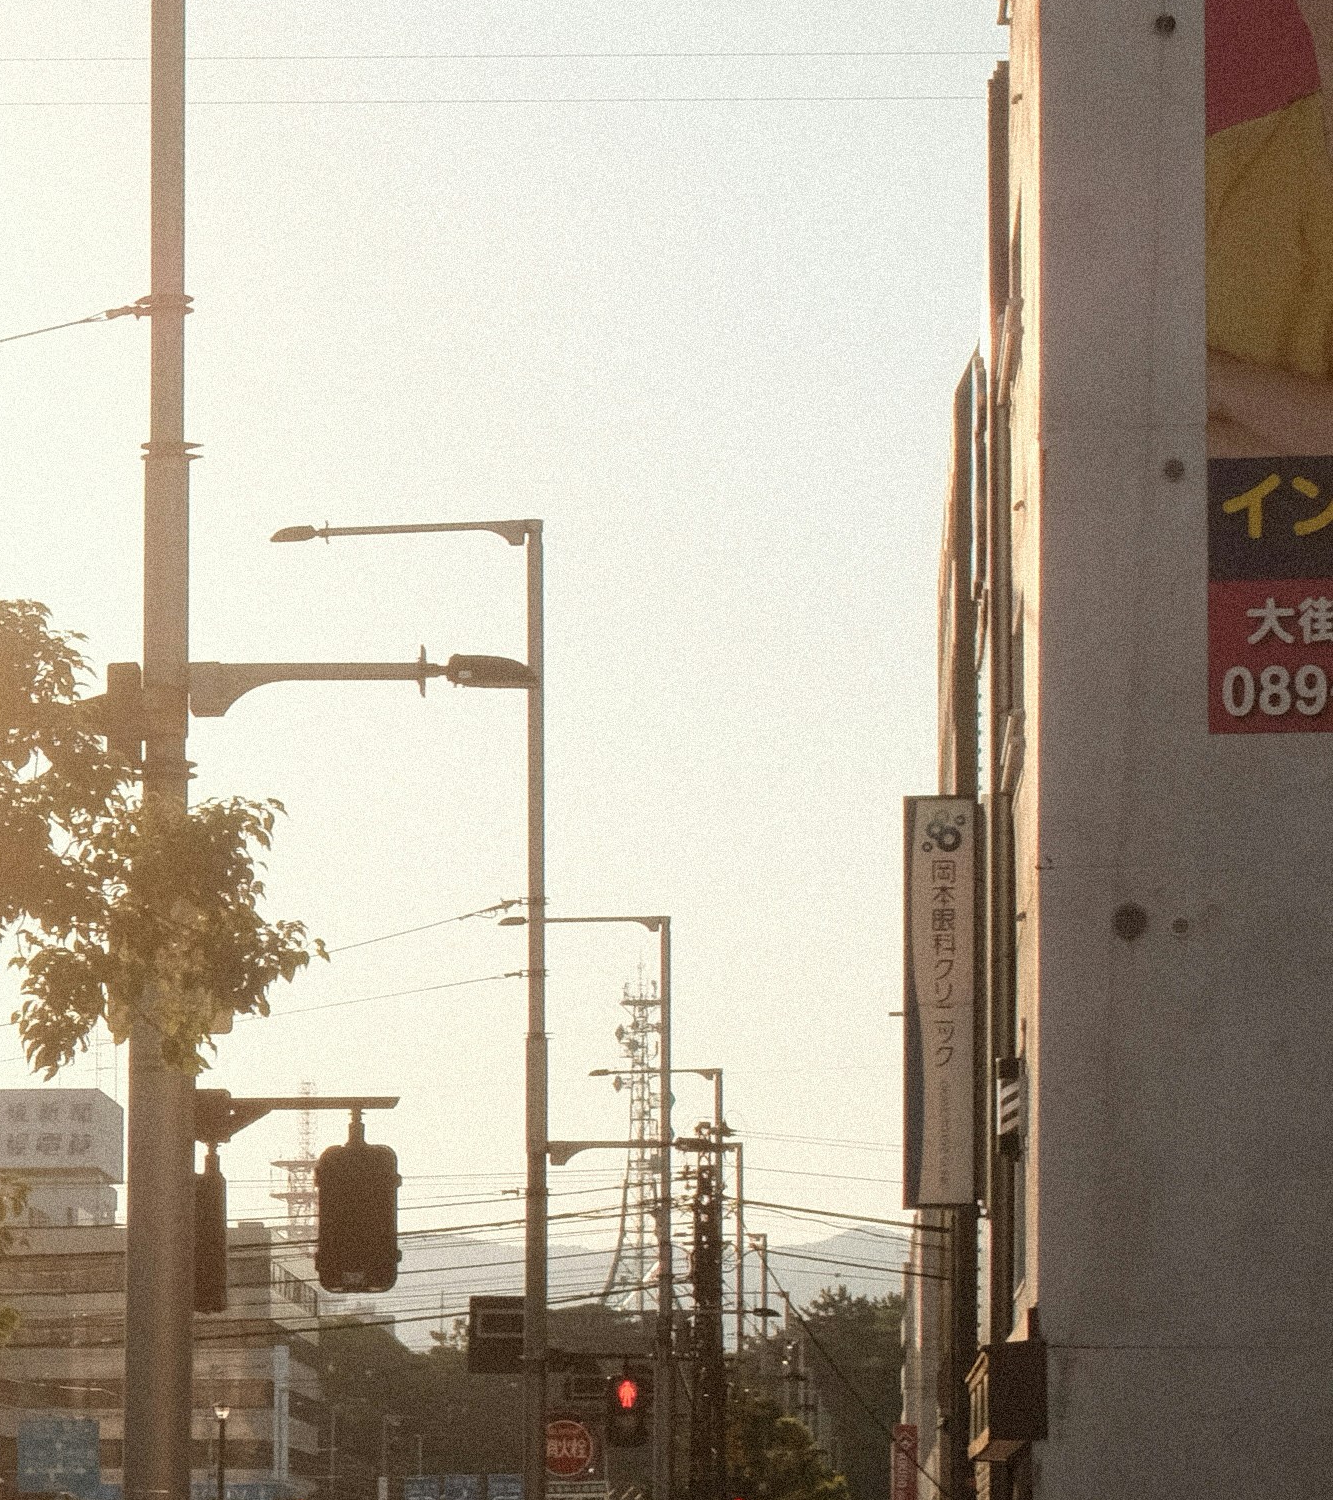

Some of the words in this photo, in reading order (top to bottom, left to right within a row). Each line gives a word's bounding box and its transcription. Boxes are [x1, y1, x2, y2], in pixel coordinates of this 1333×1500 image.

[1222, 664, 1333, 717] 089
[931, 859, 957, 1068] 岡本眼科クリニック
